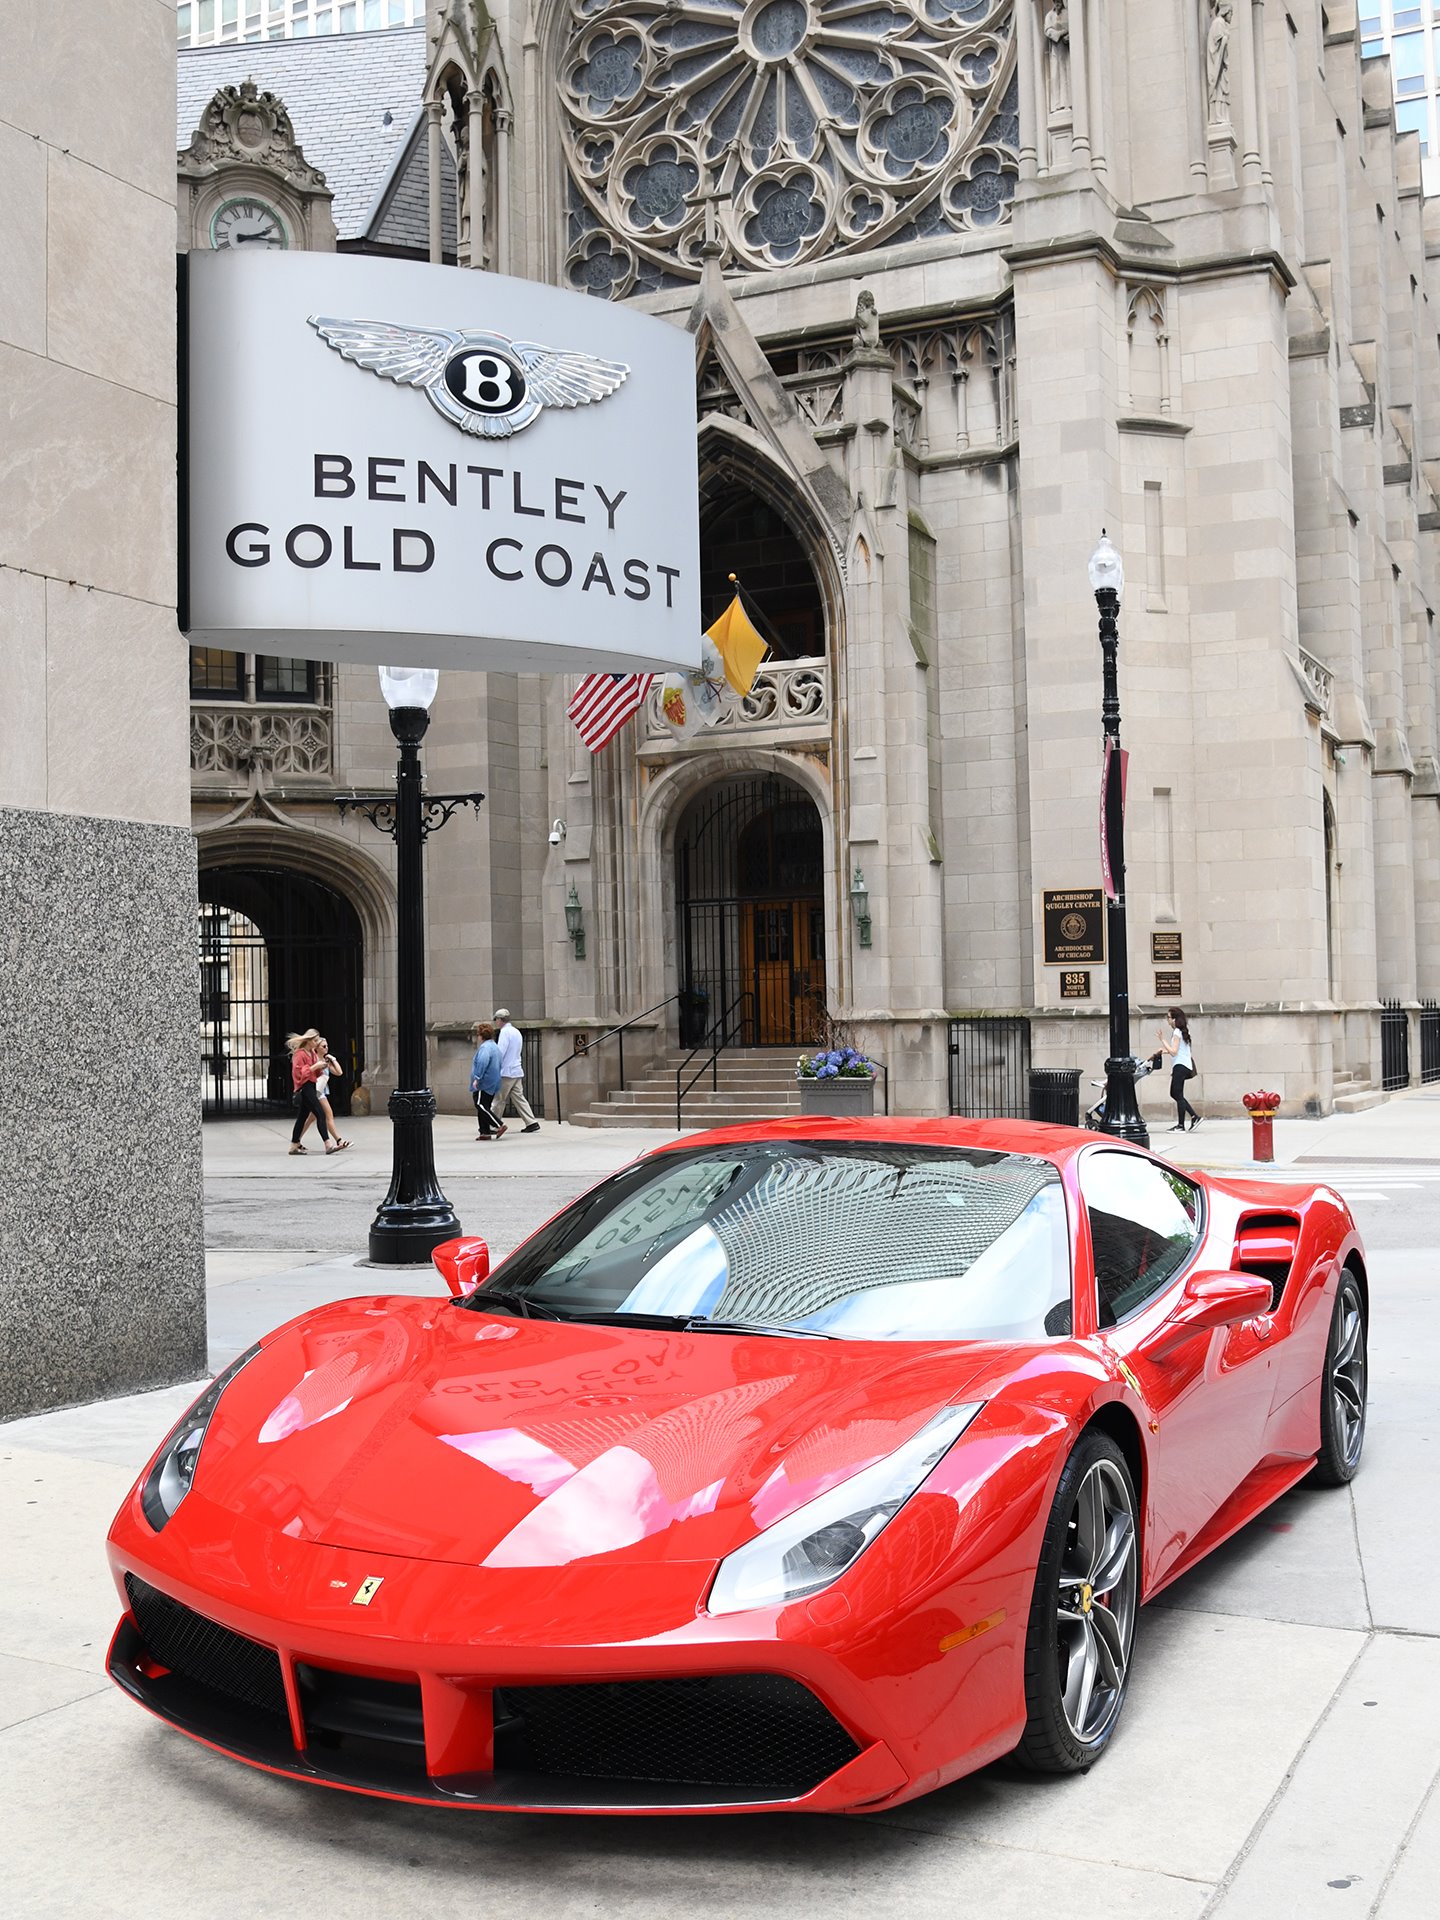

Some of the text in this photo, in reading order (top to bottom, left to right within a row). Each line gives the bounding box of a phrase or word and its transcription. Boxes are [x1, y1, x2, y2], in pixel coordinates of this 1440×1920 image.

[461, 354, 514, 408] B
[313, 453, 628, 530] BENTLEY
[225, 522, 681, 608] GOLD COAST
[1045, 902, 1074, 910] QUIGLEY
[1052, 893, 1094, 901] ARCHBISHOP
[1065, 973, 1085, 984] 835
